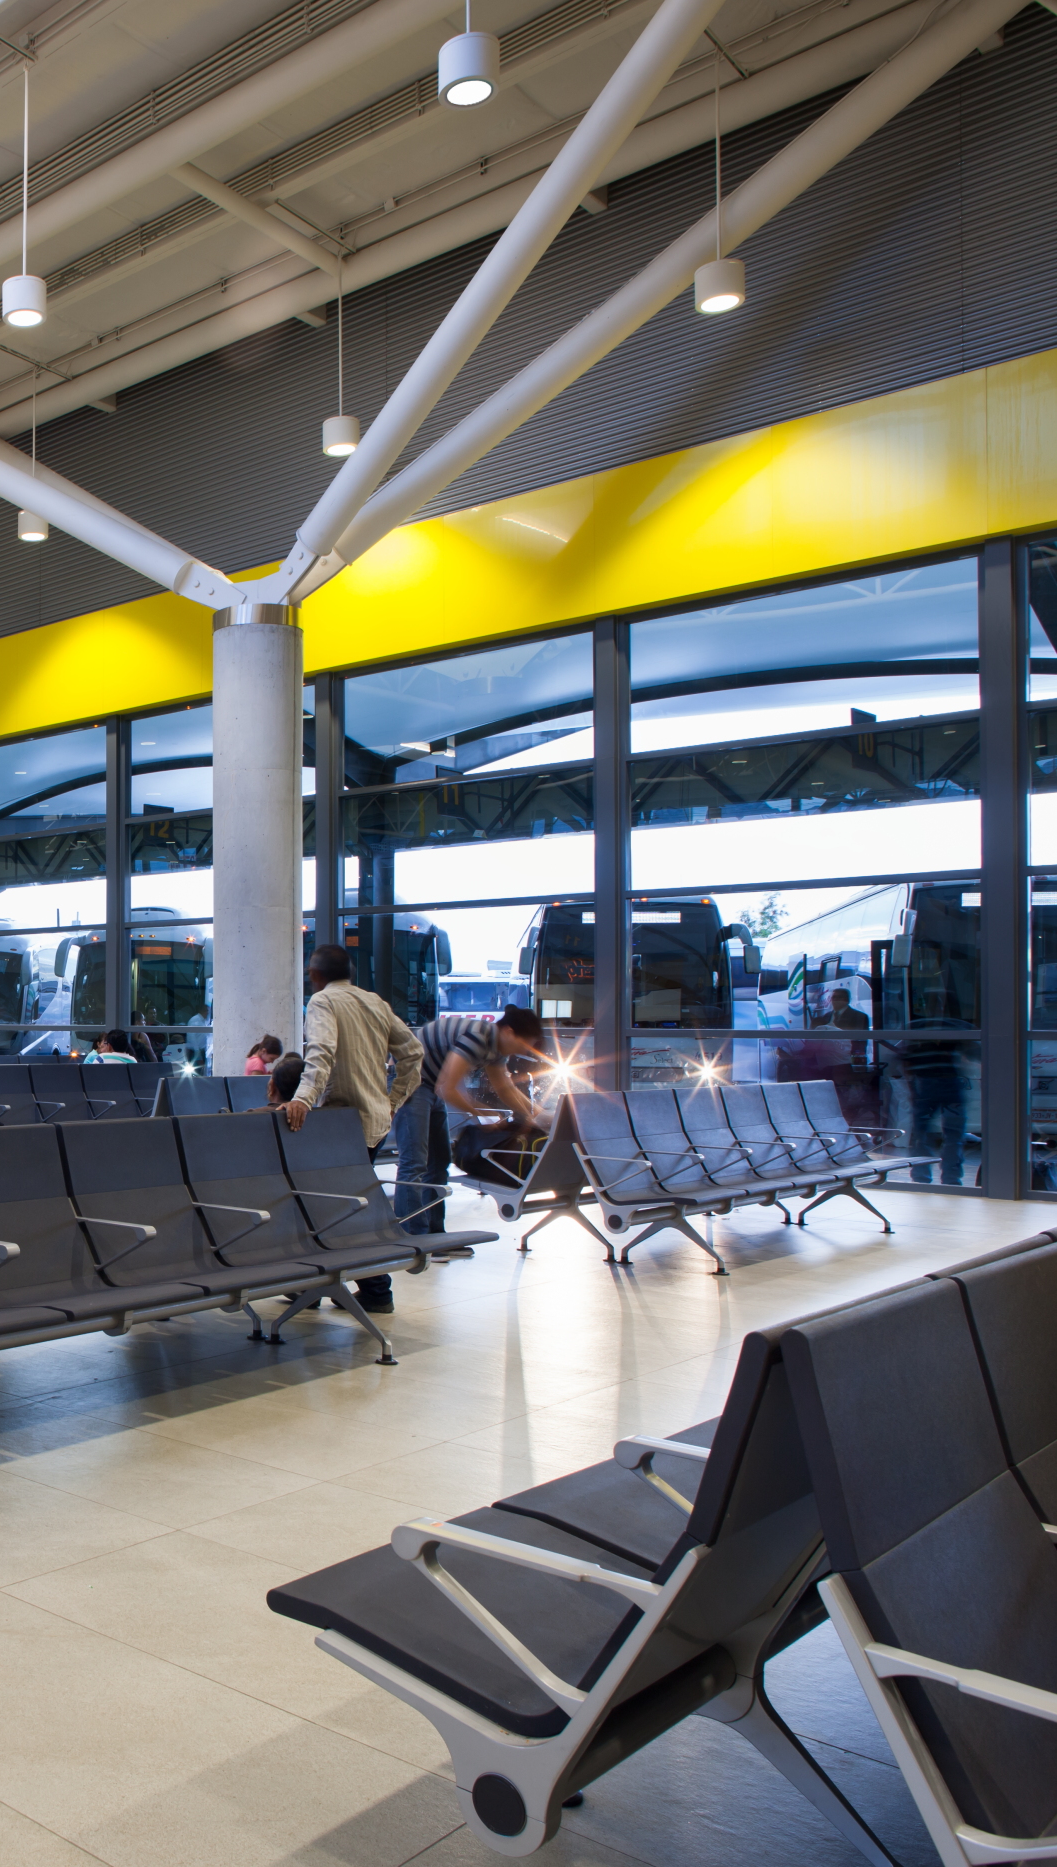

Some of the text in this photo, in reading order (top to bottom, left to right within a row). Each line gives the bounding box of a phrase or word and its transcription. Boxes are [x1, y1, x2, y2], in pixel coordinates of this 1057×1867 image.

[858, 733, 874, 758] 10
[149, 820, 170, 838] 12
[649, 1053, 674, 1065] Select
